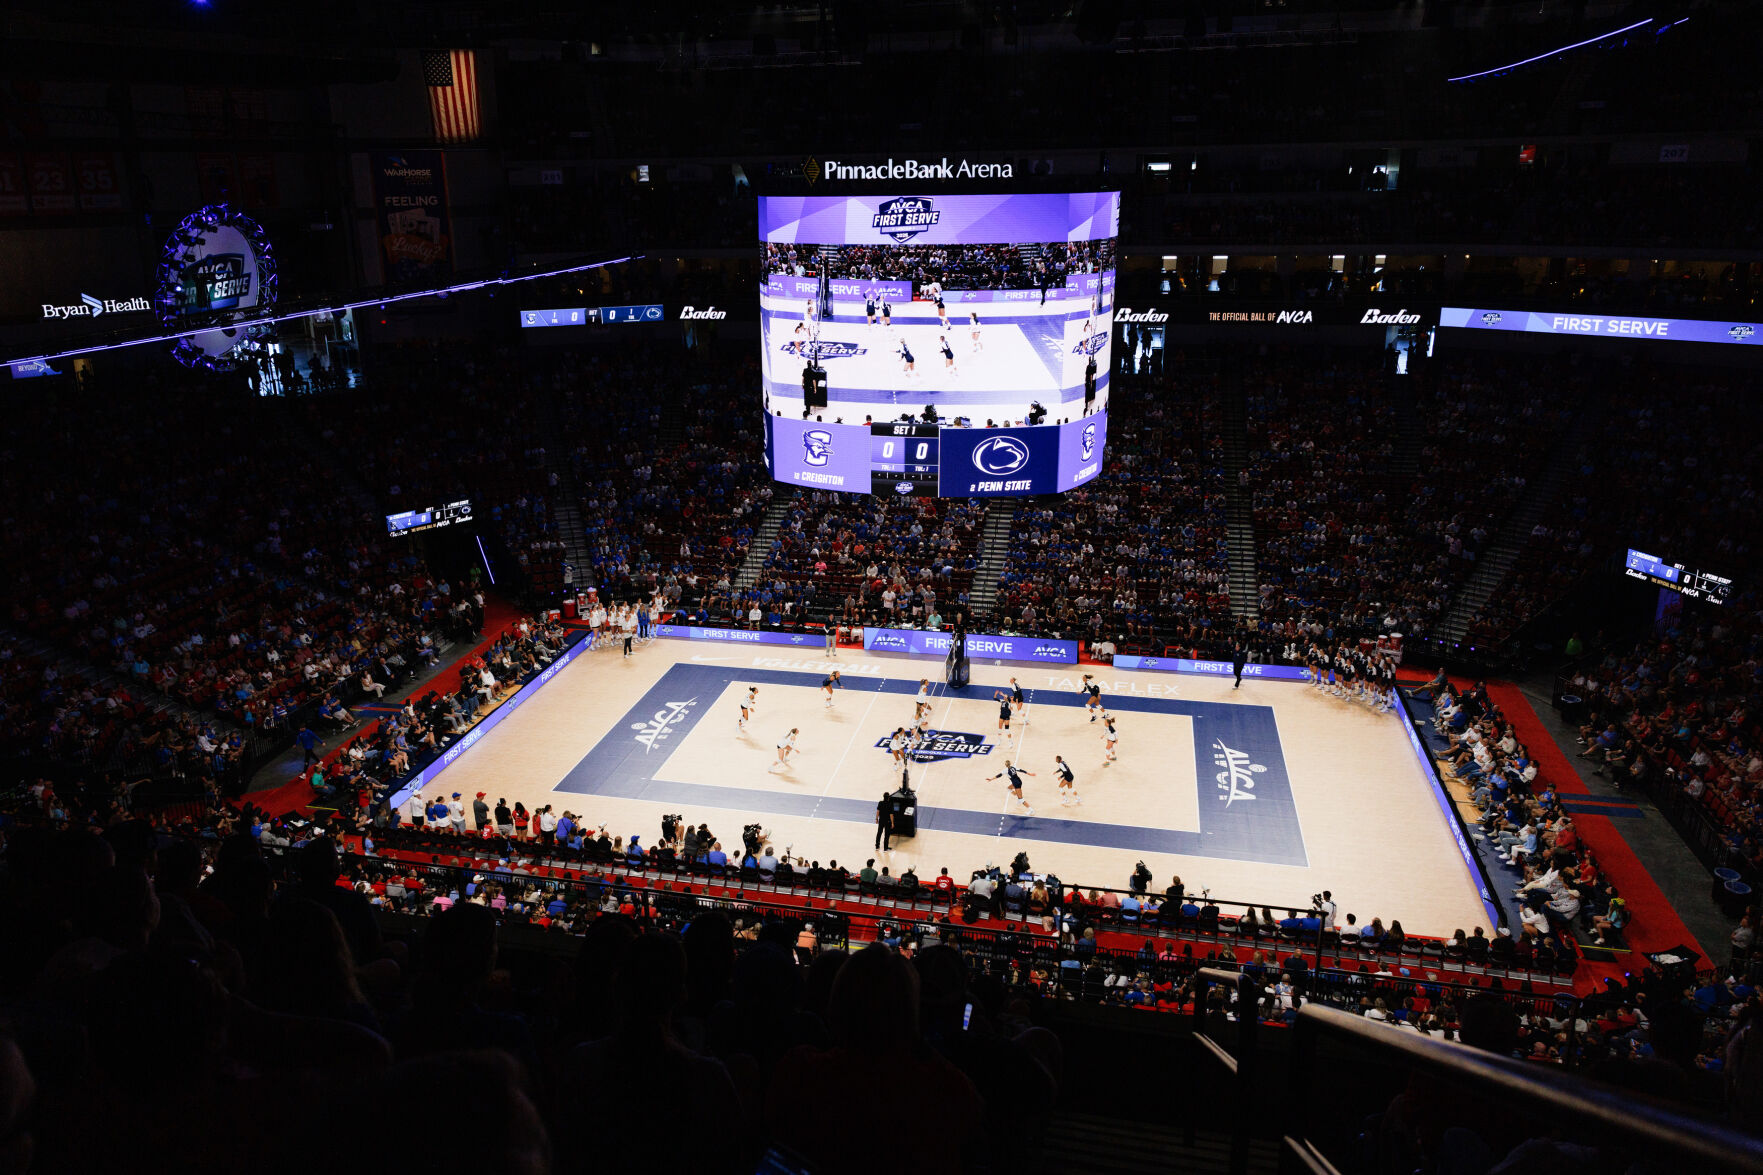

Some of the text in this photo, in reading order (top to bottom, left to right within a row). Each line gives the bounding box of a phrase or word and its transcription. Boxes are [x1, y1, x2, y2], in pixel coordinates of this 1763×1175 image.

[824, 158, 1013, 180] PinnacleBank Arena
[384, 196, 440, 207] FEELING
[887, 201, 925, 214] AVCA
[873, 212, 939, 226] FIRST SERVE
[1029, 290, 1057, 299] SEVE
[41, 297, 151, 320] Bryan Health
[609, 310, 616, 320] 0
[679, 306, 727, 320] Baden
[1114, 308, 1169, 323] Baden
[1360, 308, 1421, 323] Baden
[1209, 310, 1313, 324] THE OFFICIAL BALL OF AVCA
[1553, 317, 1670, 336] FIRST SERVE
[893, 425, 916, 435] SET 1
[882, 441, 895, 458] 0
[915, 442, 929, 460] 0
[801, 471, 844, 486] CREIGHTON
[977, 481, 1003, 492] PENN
[1004, 480, 1032, 491] STATE
[1665, 568, 1673, 578] 0
[1683, 574, 1691, 584] 0
[1681, 586, 1699, 598] AVCA
[703, 629, 760, 645] FIRST SERVE
[873, 636, 906, 648] AVCA
[967, 641, 1013, 654] SERVE
[1032, 646, 1067, 658] AVCA
[541, 653, 571, 682] FIRST SERVE
[751, 656, 881, 675] VOLLEYBALL
[1194, 662, 1262, 675] FIRST SRVE
[634, 697, 698, 751] AVCA
[443, 726, 482, 765] FIRST SERVE
[933, 742, 989, 754] SERVE
[1213, 738, 1257, 806] AVCA
